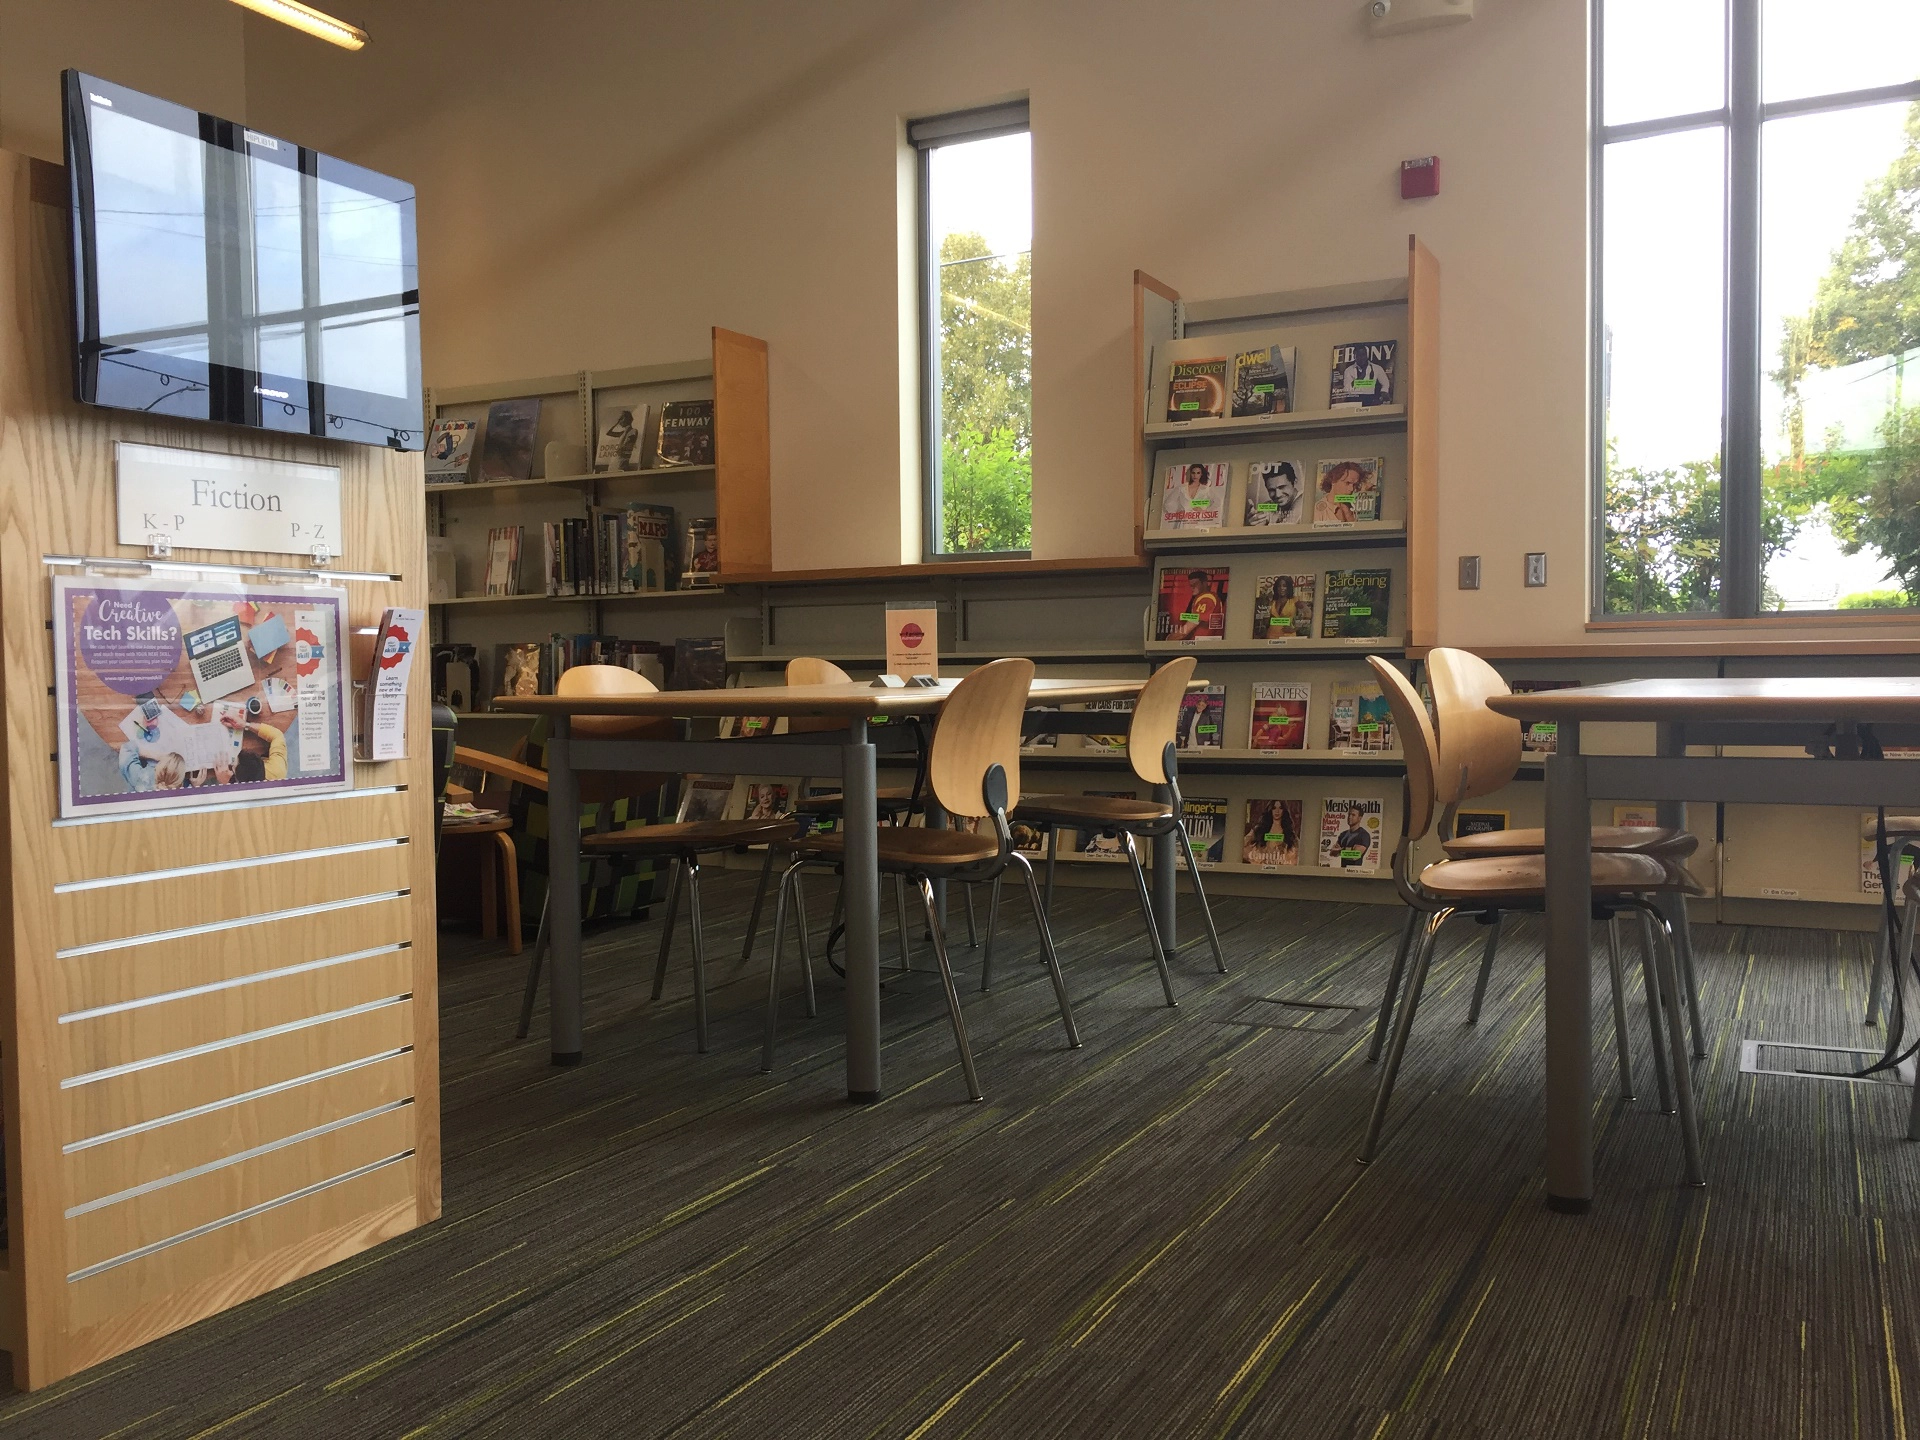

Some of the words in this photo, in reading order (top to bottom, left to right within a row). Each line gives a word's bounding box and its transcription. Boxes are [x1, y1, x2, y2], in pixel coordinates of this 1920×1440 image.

[1236, 347, 1272, 367] dwell
[1173, 363, 1226, 377] Discover
[1173, 380, 1208, 391] ECLIPSE
[664, 416, 711, 428] FENWAY
[1251, 462, 1282, 475] OUT
[191, 479, 283, 512] Fiction
[143, 513, 158, 529] K
[174, 515, 185, 531] P
[1164, 511, 1201, 521] SEPTEMBER
[1201, 510, 1219, 519] ISSUE
[291, 523, 300, 537] P
[314, 525, 325, 539] Z
[638, 521, 668, 537] MAPS
[1328, 574, 1387, 588] Gardening
[98, 599, 163, 623] Creative
[113, 601, 133, 609] Need
[84, 625, 121, 640] Tech
[126, 626, 178, 641] Skills?
[1097, 701, 1112, 710] CARS
[1112, 701, 1123, 710] FOR
[1183, 801, 1215, 814] linger's
[1325, 799, 1349, 813] Men's
[1348, 799, 1381, 814] Health
[1324, 812, 1346, 820] Muscle
[1322, 824, 1340, 833] Easy!
[1320, 839, 1332, 847] 49
[1863, 870, 1882, 880] The
[1863, 880, 1901, 889] Gens
